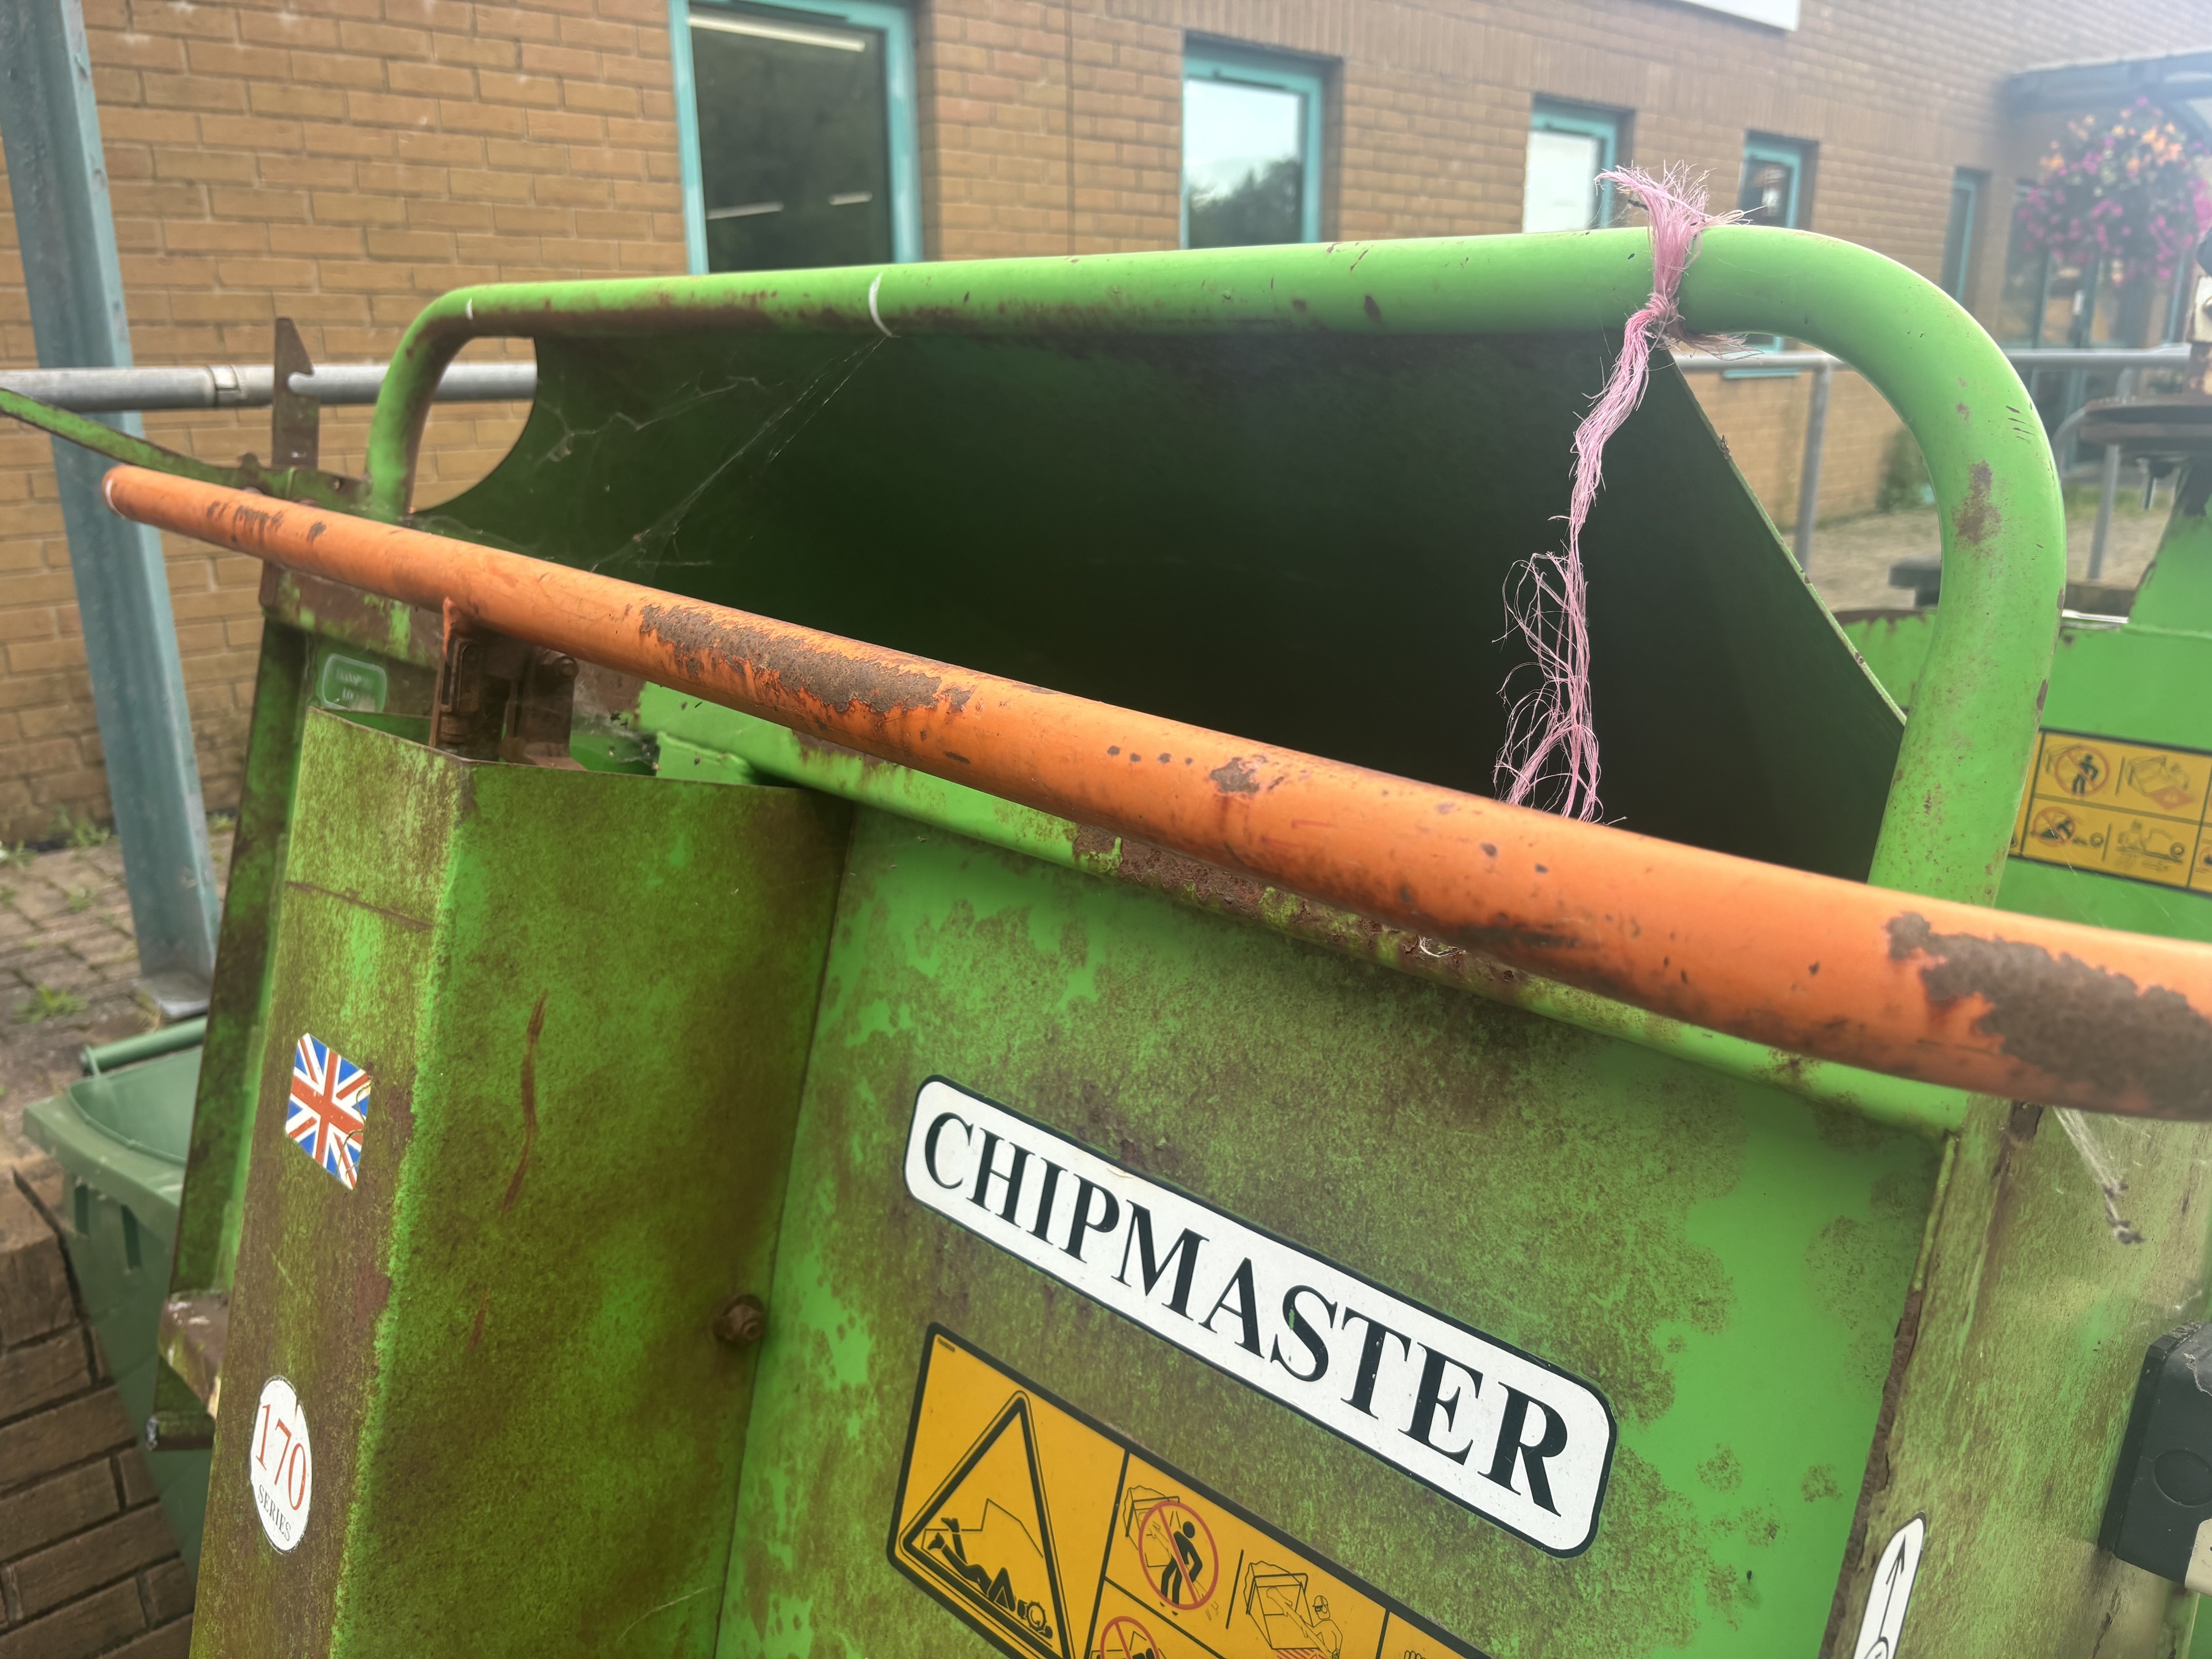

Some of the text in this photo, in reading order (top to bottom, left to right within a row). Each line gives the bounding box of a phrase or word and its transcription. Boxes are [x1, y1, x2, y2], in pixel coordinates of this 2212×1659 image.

[925, 1112, 1568, 1517] CHIPMASTER
[256, 1404, 306, 1510] 170
[258, 1484, 291, 1541] SERIES
